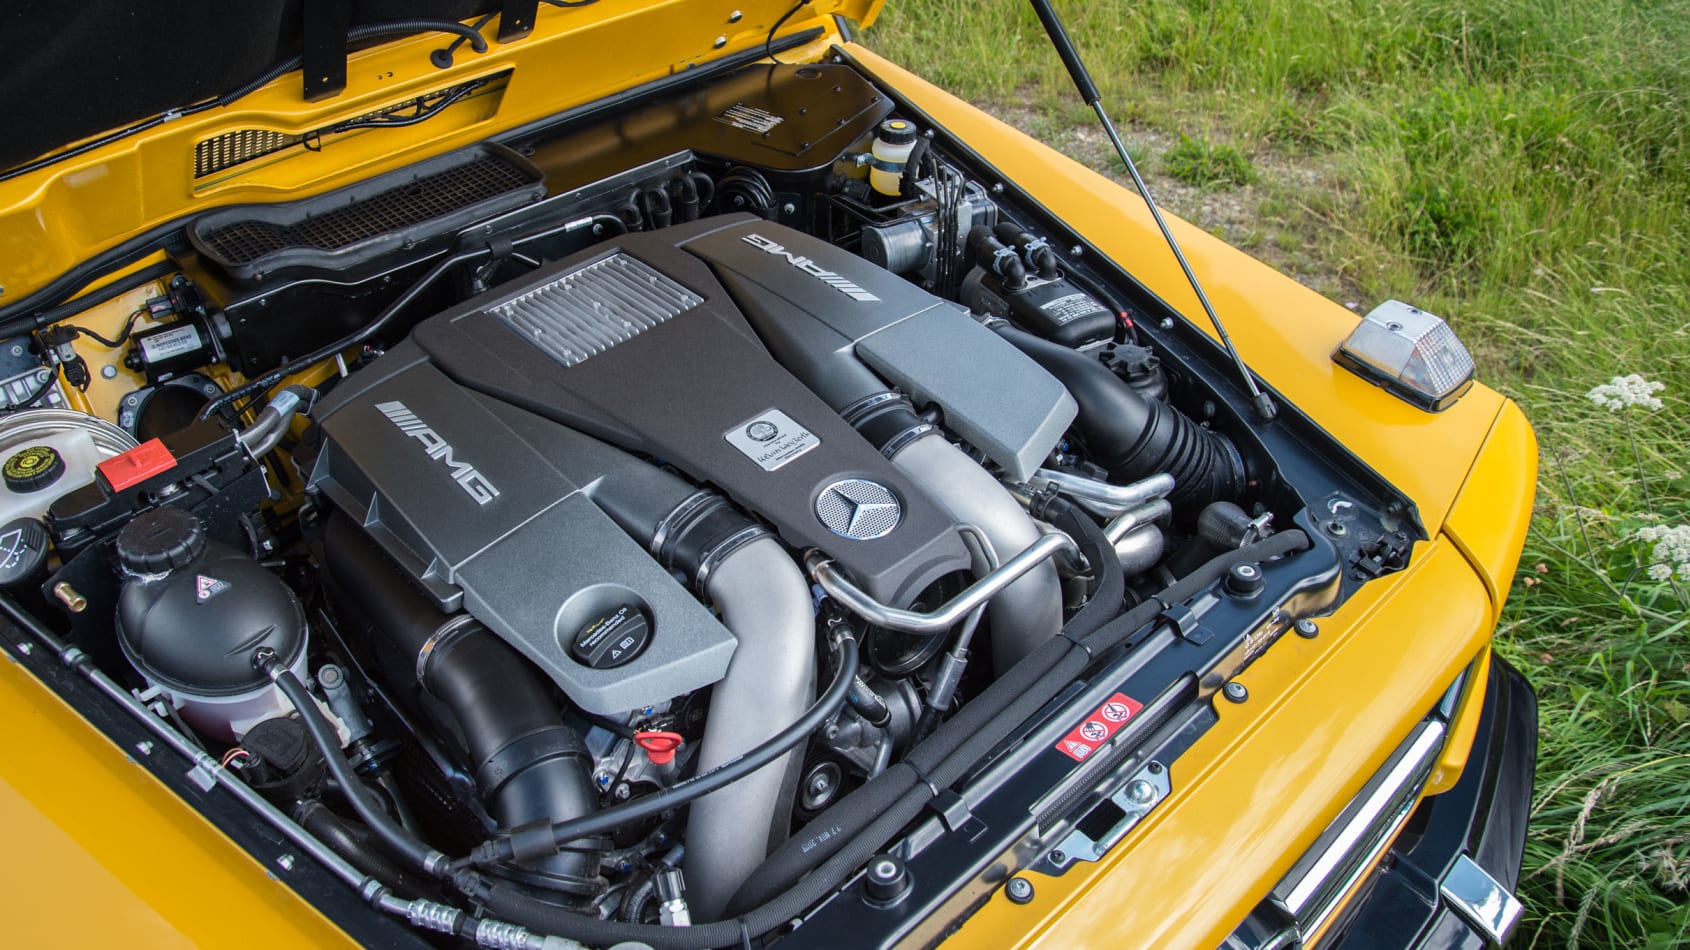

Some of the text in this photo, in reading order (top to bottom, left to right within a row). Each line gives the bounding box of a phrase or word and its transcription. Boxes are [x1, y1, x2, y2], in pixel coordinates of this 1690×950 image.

[741, 233, 838, 277] AMG
[404, 427, 500, 505] AMG
[580, 614, 619, 647] Mercedes-Benz
[589, 616, 626, 647] recommended
